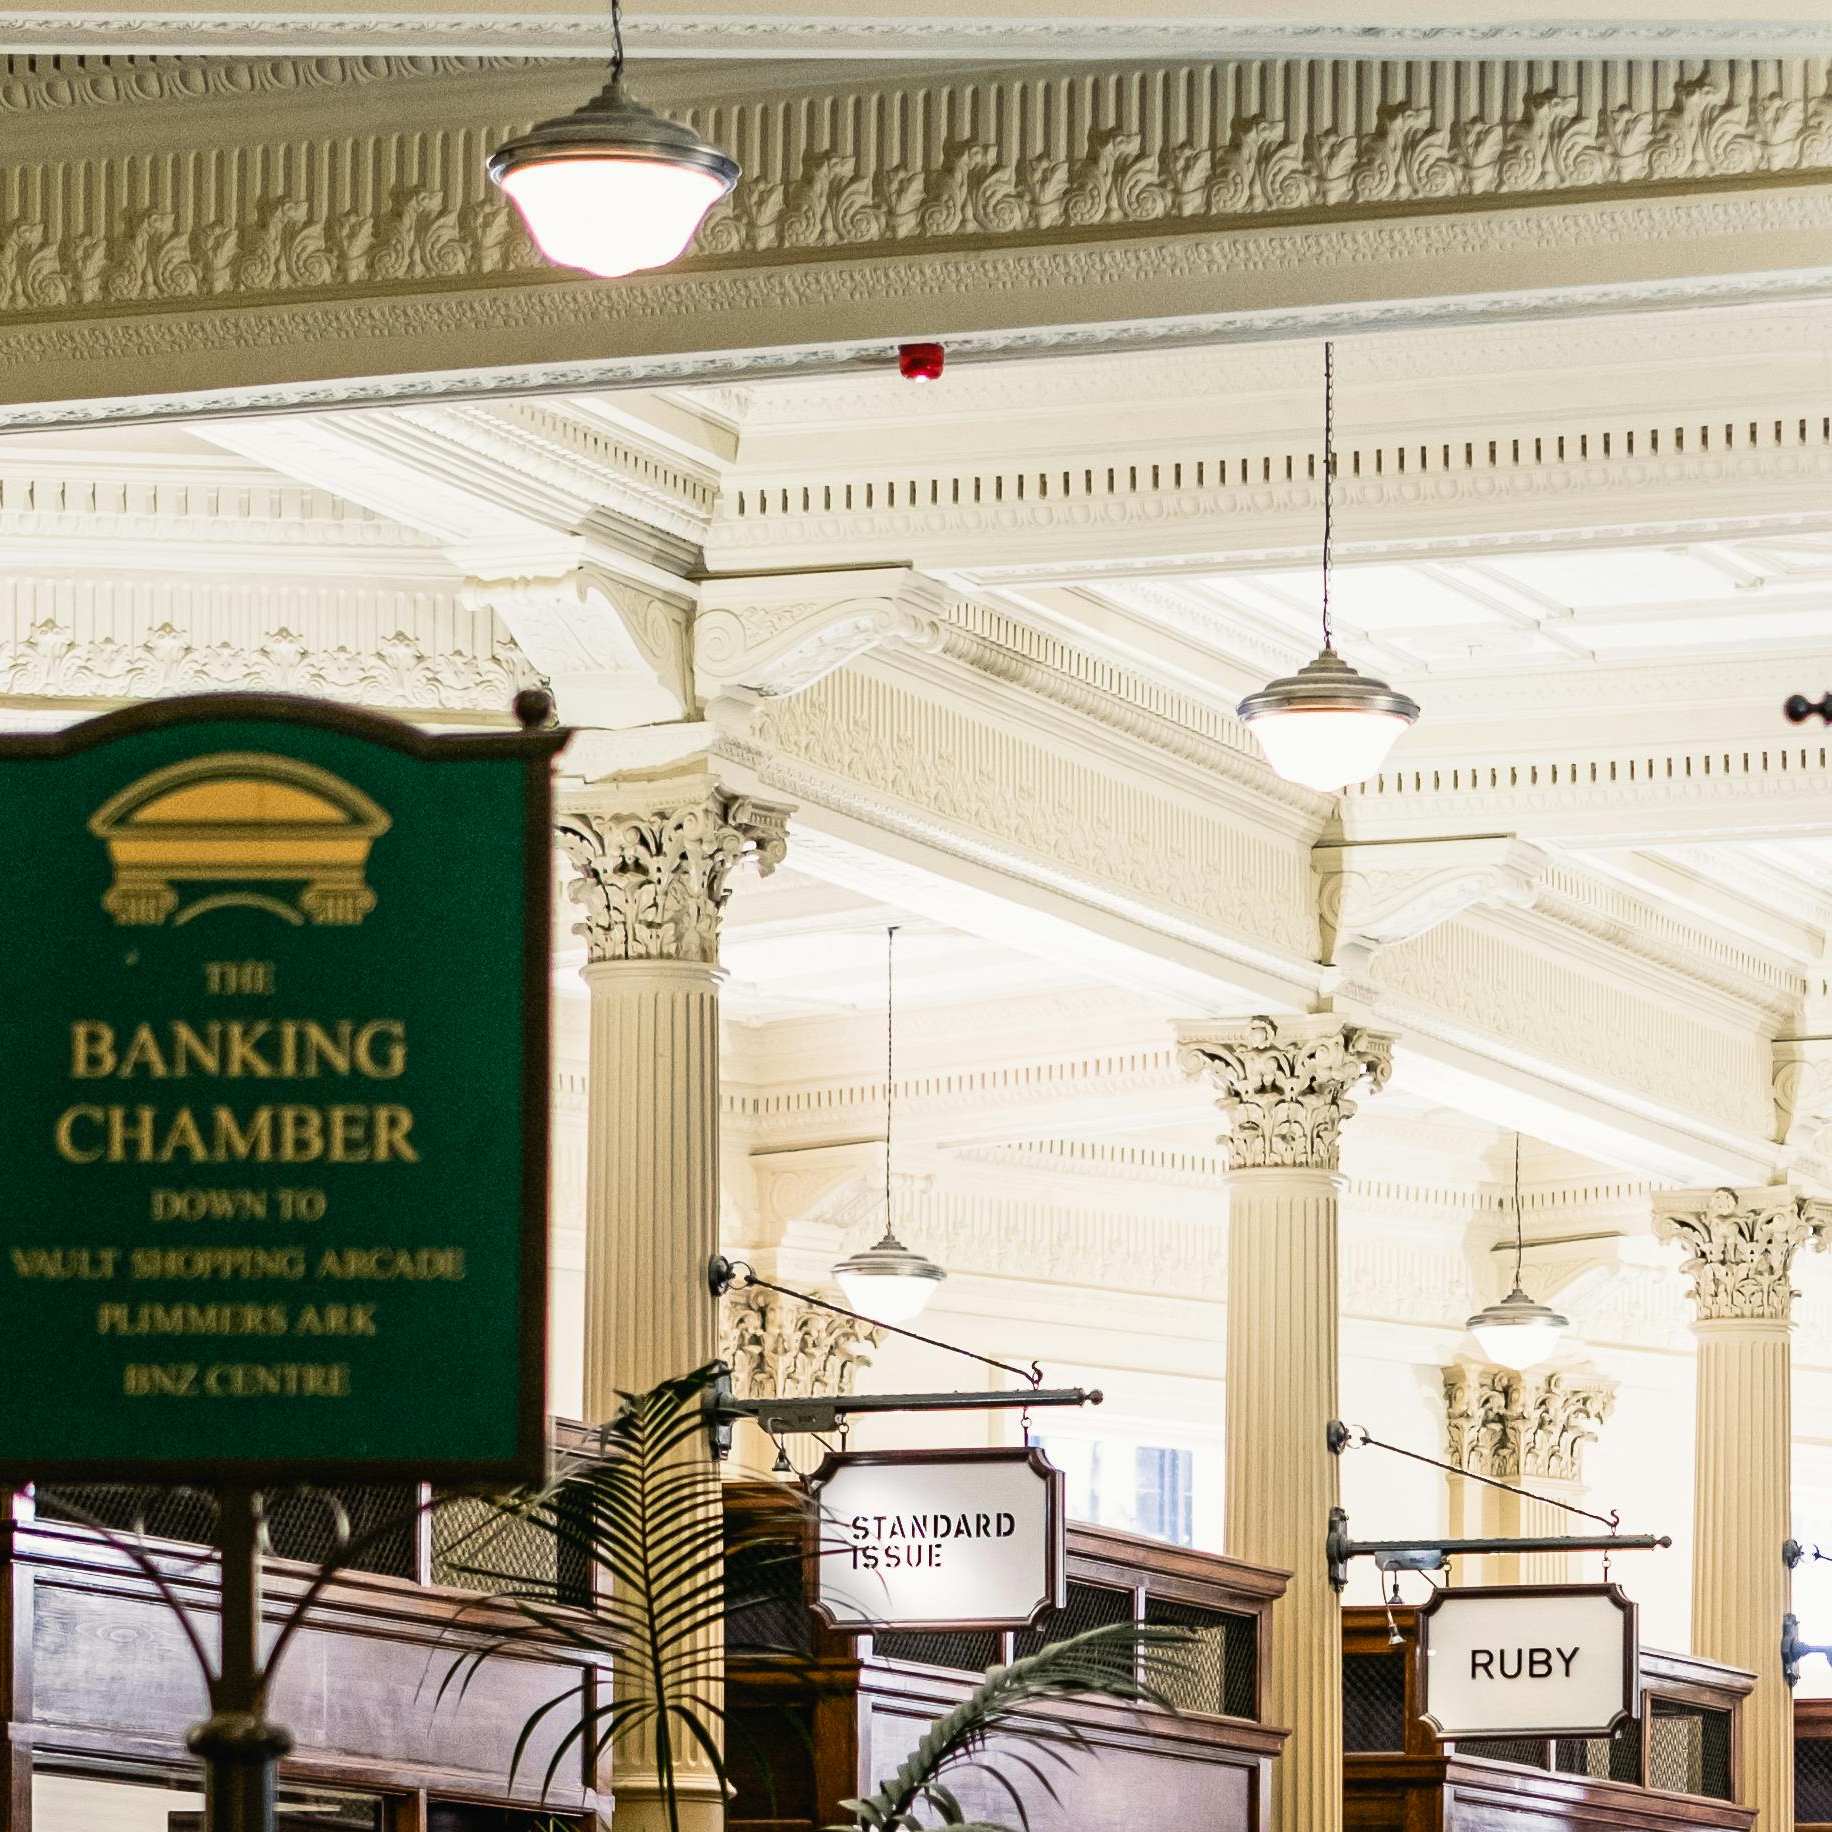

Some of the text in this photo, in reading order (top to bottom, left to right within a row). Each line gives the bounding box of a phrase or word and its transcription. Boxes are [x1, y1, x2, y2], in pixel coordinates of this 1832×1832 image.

[205, 961, 274, 995] THE
[70, 1021, 408, 1079] BANKING
[54, 1105, 419, 1163] CHAMBER
[150, 1190, 327, 1221] DOWN TO
[12, 1248, 465, 1279] VAULT SHOPPING ARCADE
[97, 1304, 376, 1336] PLIMMERS ARK
[124, 1364, 351, 1397] BNZ CENTRE
[851, 1512, 1016, 1541] STANDARD
[851, 1544, 943, 1570] ISSUE
[1470, 1646, 1580, 1680] RUBY
